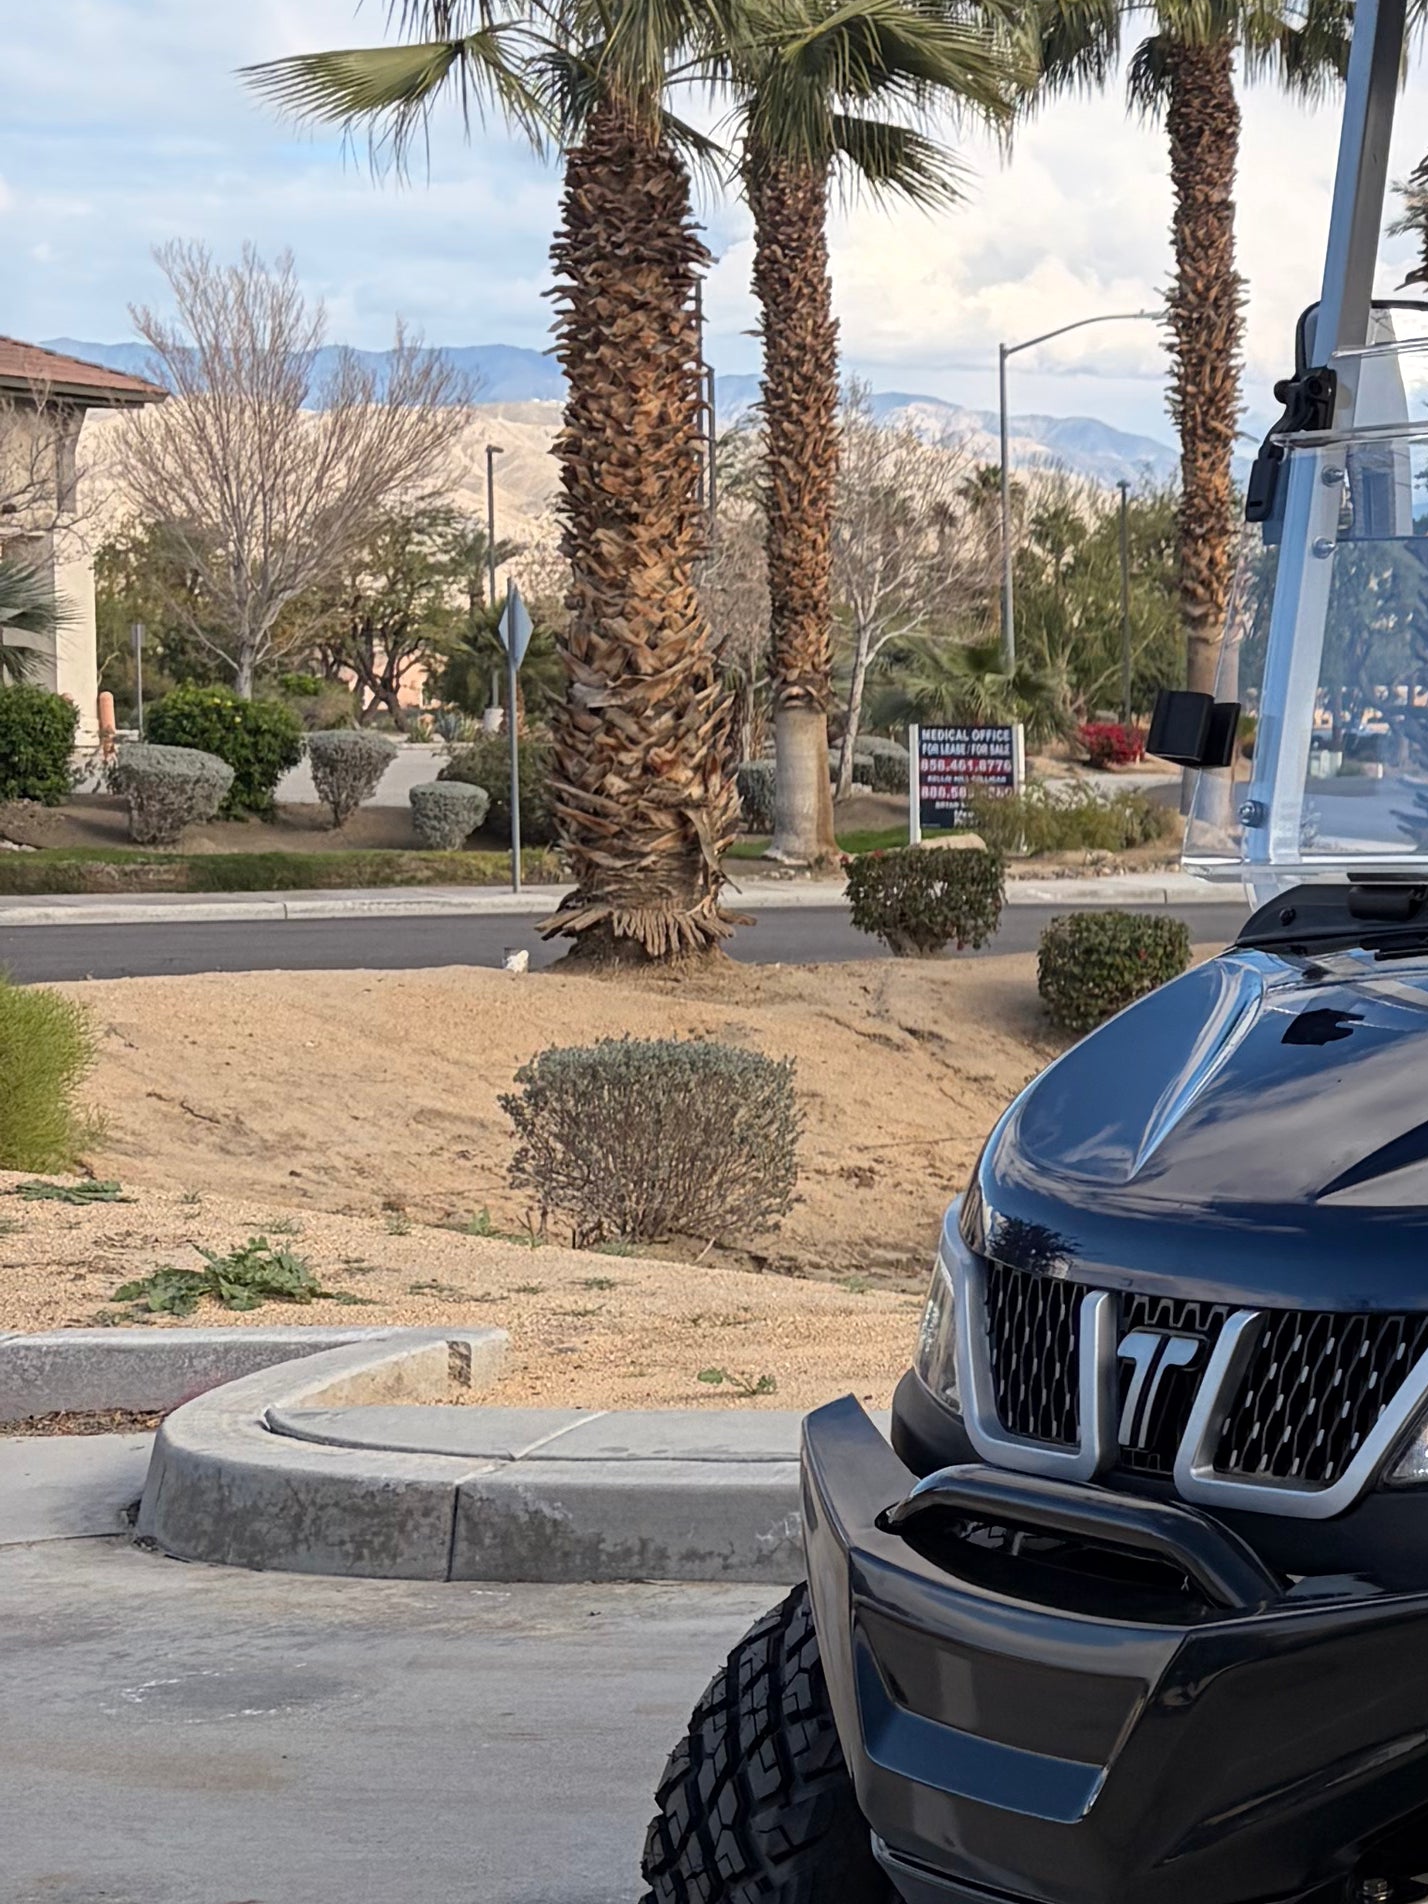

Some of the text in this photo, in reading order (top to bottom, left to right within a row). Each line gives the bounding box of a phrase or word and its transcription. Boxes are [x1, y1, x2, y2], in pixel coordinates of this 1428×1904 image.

[922, 728, 1010, 742] MEDICAL OFFICE
[922, 743, 939, 755] FOR
[940, 743, 966, 755] LEASE
[971, 744, 988, 755] FOR
[989, 744, 1010, 755] SALE
